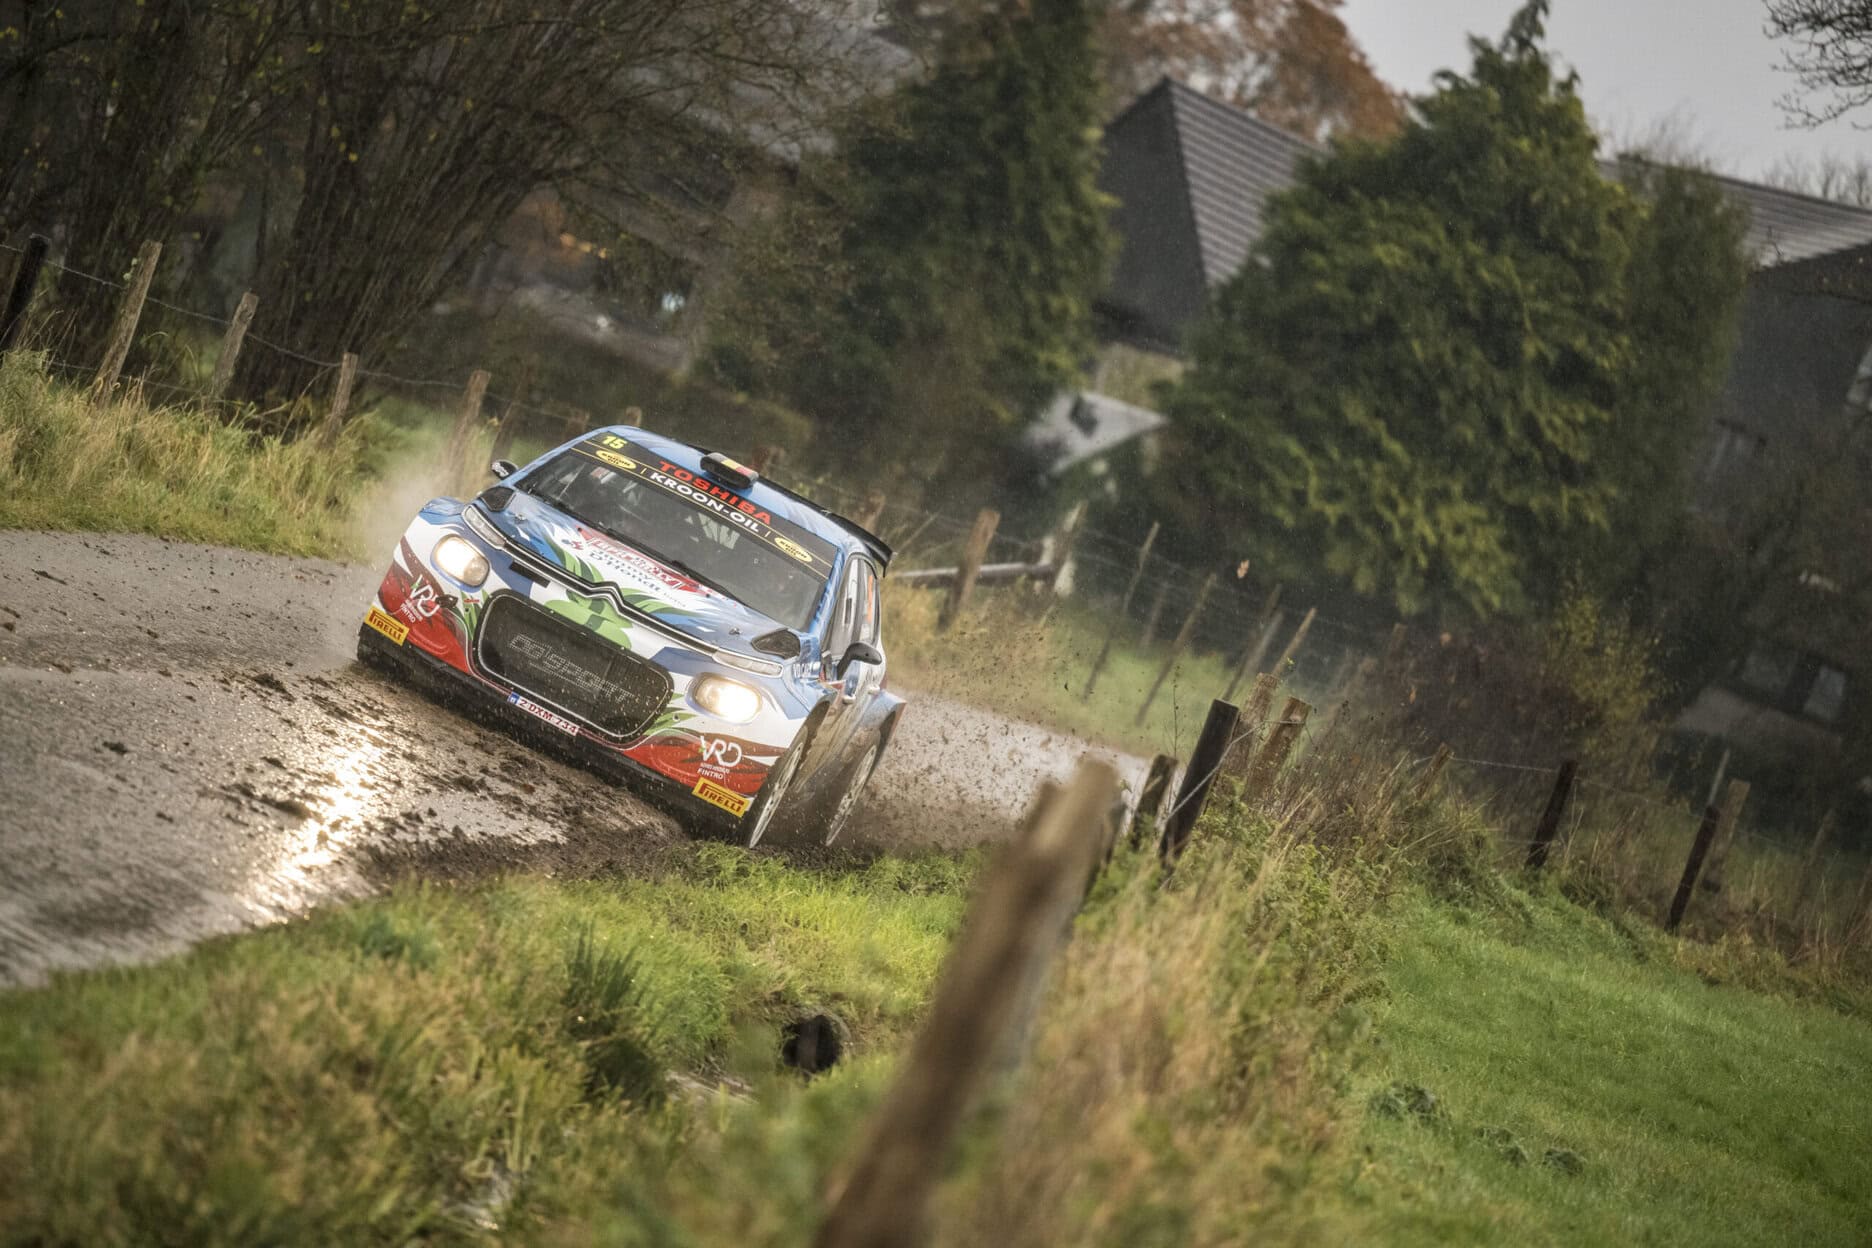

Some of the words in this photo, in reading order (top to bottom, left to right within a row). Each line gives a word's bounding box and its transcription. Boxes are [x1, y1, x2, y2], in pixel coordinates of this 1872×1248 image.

[600, 435, 628, 450] 15
[650, 472, 760, 533] KROON-OIL
[658, 460, 772, 525] TOSHIBA
[368, 610, 404, 642] PIRELLI
[697, 768, 724, 780] FINTRO
[699, 783, 745, 813] PIRELLI
